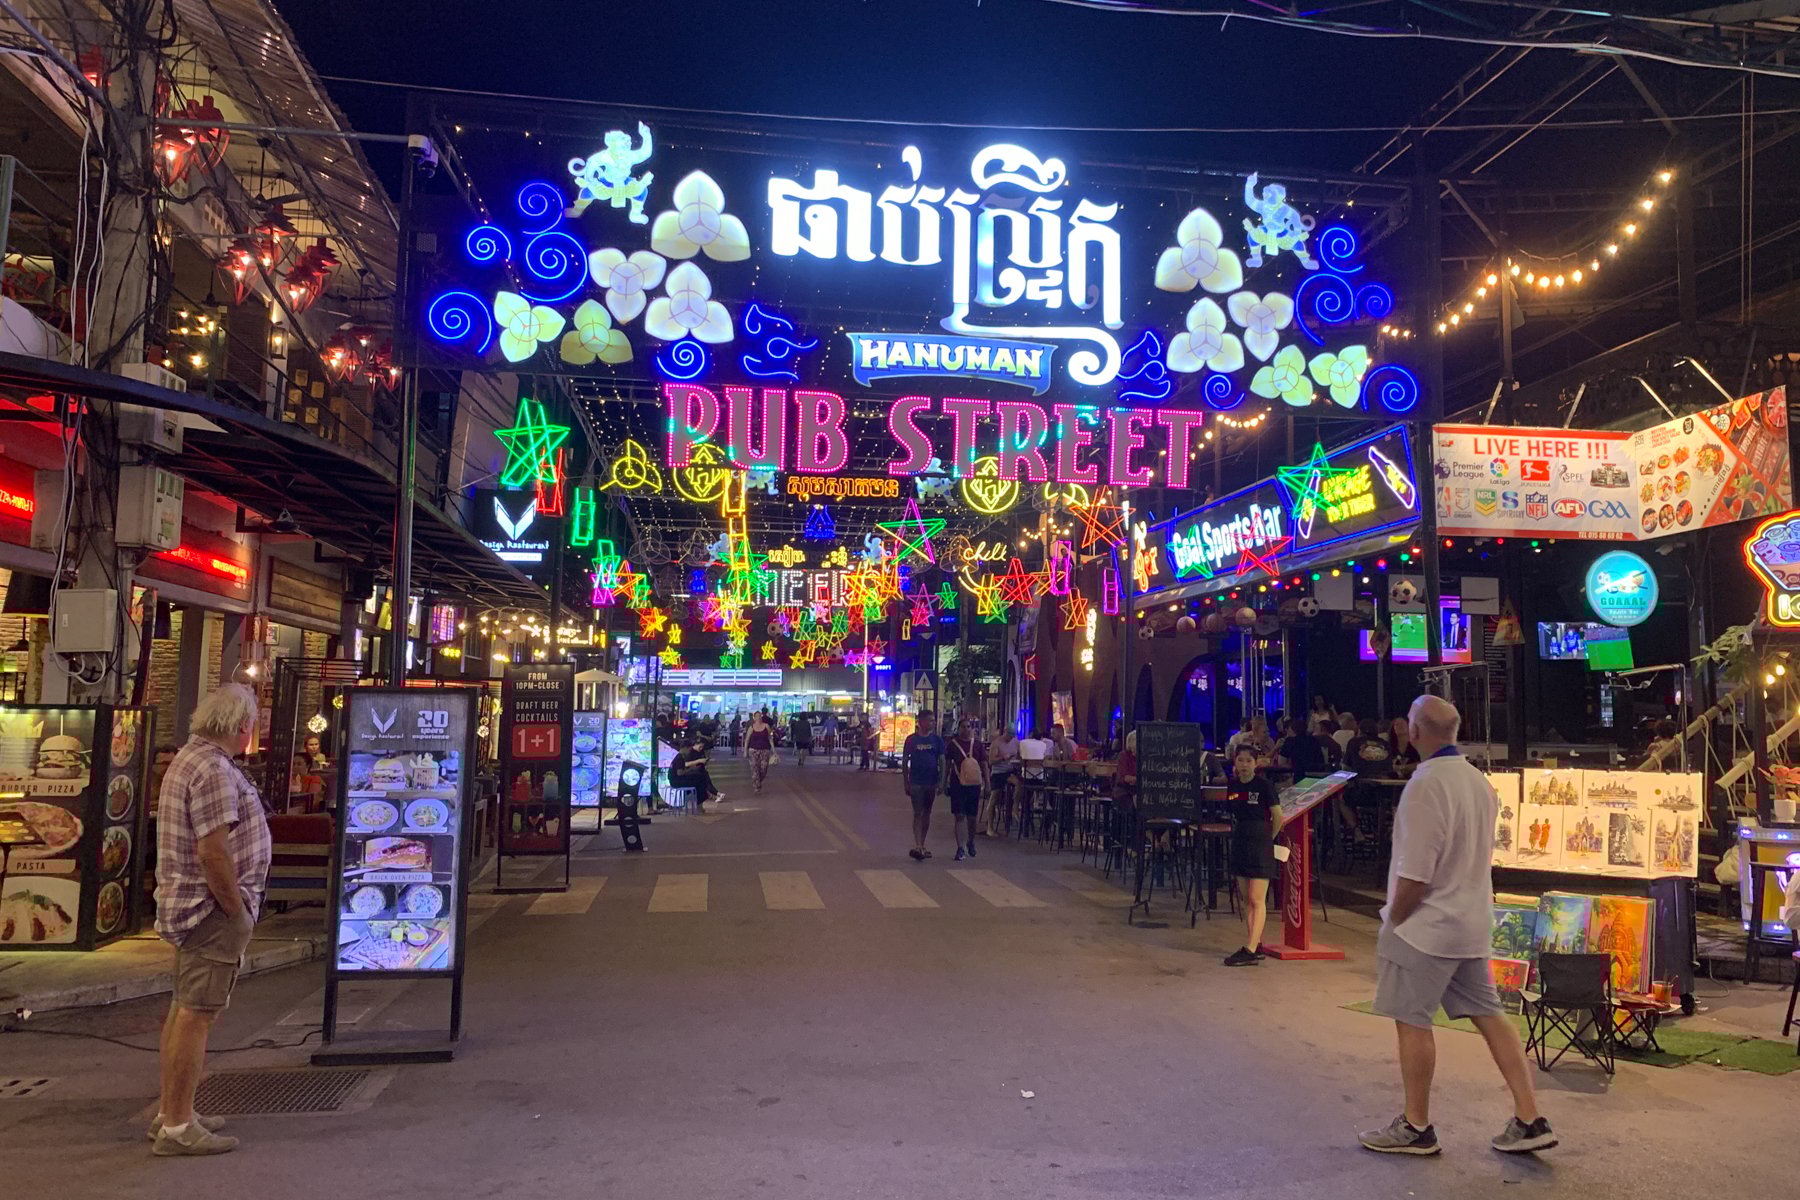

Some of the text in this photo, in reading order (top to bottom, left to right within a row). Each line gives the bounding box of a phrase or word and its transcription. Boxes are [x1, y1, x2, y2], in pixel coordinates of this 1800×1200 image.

[859, 337, 1044, 378] HANUMAN
[664, 382, 1204, 490] PUB STREET
[1473, 437, 1520, 457] LIVE
[1527, 439, 1580, 459] HERE
[1452, 461, 1485, 470] Premier
[1452, 470, 1485, 480] League
[1565, 472, 1584, 480] SPFL
[1527, 503, 1547, 518] NFL
[1554, 502, 1585, 514] AFL
[1172, 503, 1282, 569] Goal Sports Bar
[1600, 597, 1647, 606] GOAAAL
[528, 672, 548, 680] FROM
[516, 681, 560, 690] 10PM-CLOSE
[516, 701, 559, 710] DRAFT BEER
[418, 710, 448, 728] 20
[515, 713, 559, 723] COCKTAILS
